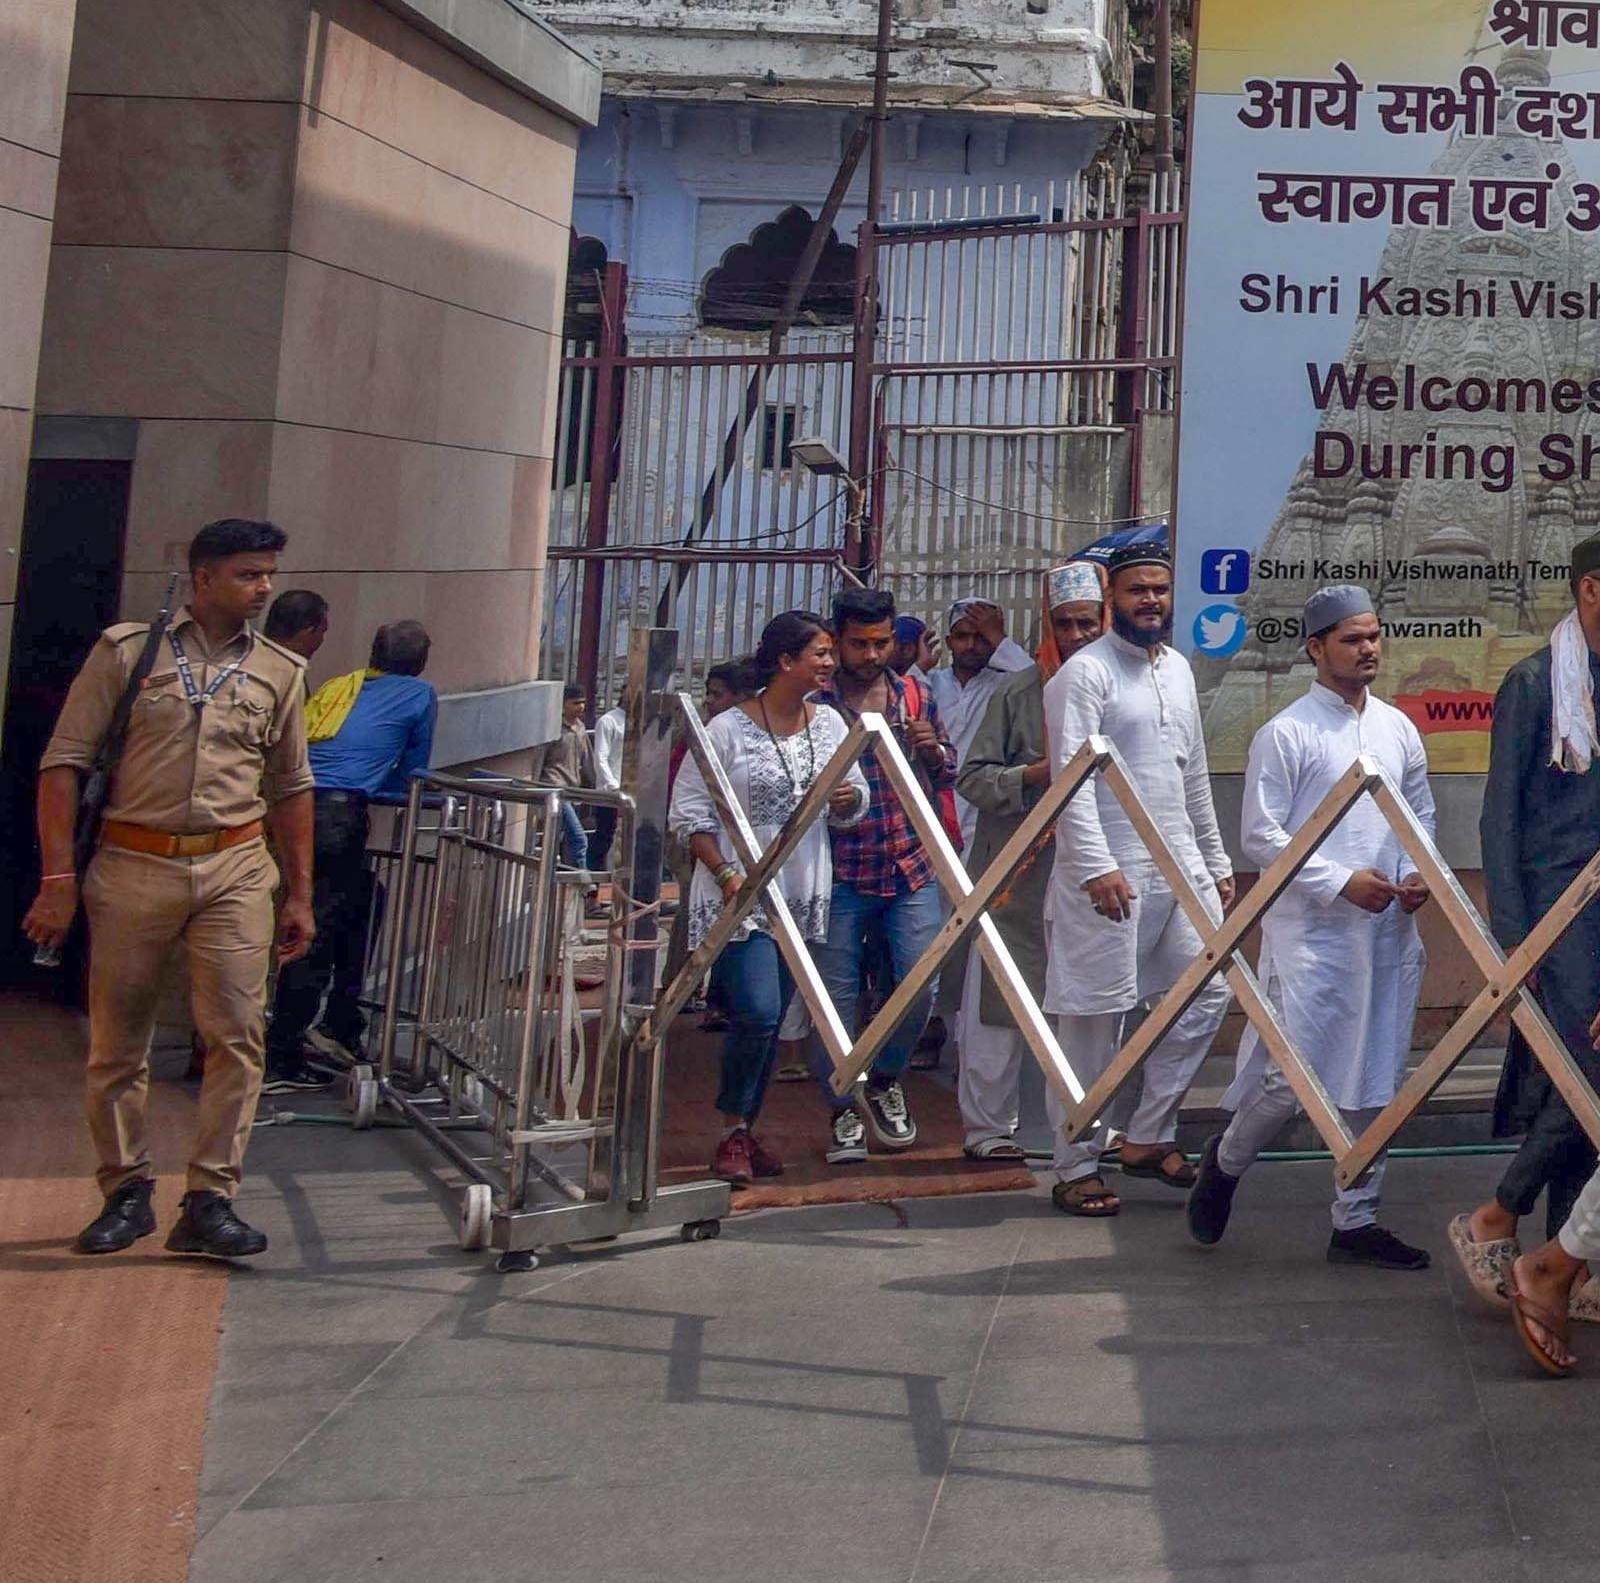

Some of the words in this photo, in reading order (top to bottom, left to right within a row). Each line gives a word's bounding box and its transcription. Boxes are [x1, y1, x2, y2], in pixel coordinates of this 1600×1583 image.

[1237, 62, 1364, 131] आये
[1377, 66, 1500, 136] सभी
[1257, 172, 1455, 226] स्वागत
[1469, 162, 1562, 232] एवं
[1239, 273, 1340, 315] Shri
[1359, 276, 1497, 318] Kashi
[1313, 430, 1515, 494] During
[1257, 558, 1306, 580] Shri
[1313, 559, 1380, 581] Kashi
[1386, 559, 1520, 581] Vishwanath
